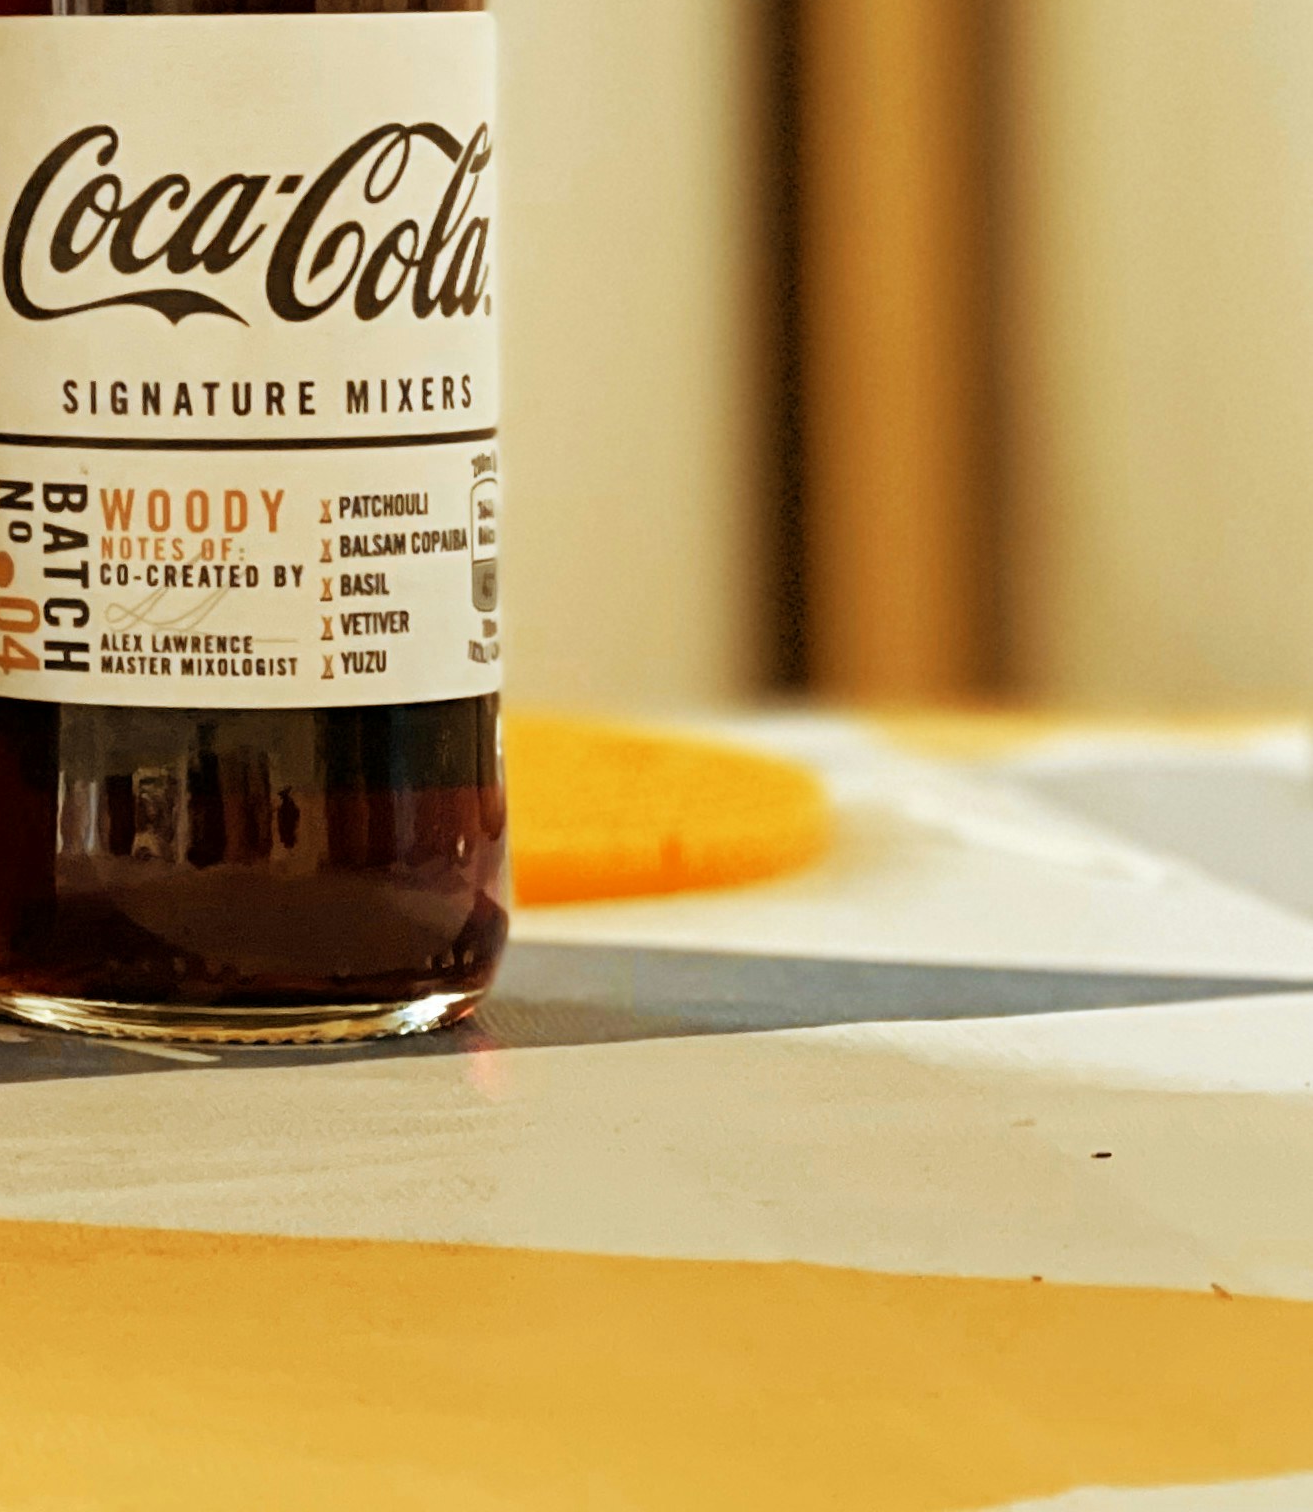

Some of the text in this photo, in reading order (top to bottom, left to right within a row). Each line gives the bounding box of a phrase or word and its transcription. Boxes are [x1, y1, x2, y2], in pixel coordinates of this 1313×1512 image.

[2, 122, 491, 327] Coca-Cola
[62, 374, 473, 417] SIGNATURE MIXERS
[99, 488, 285, 533] WOODY
[339, 492, 429, 519] PATCHOULI
[100, 536, 246, 562] NOTES OF:
[339, 533, 406, 559] BALSAM
[411, 528, 468, 554] COPAIBA
[42, 482, 90, 673] BATCH
[99, 564, 304, 588] CO-CREATED BY
[340, 573, 390, 597] BASIL
[340, 610, 410, 636] VETIVER
[100, 633, 253, 654] ALEX LAWRENCE
[100, 656, 298, 677] MASTER MIXOLOGIST
[340, 650, 387, 675] YUZU
